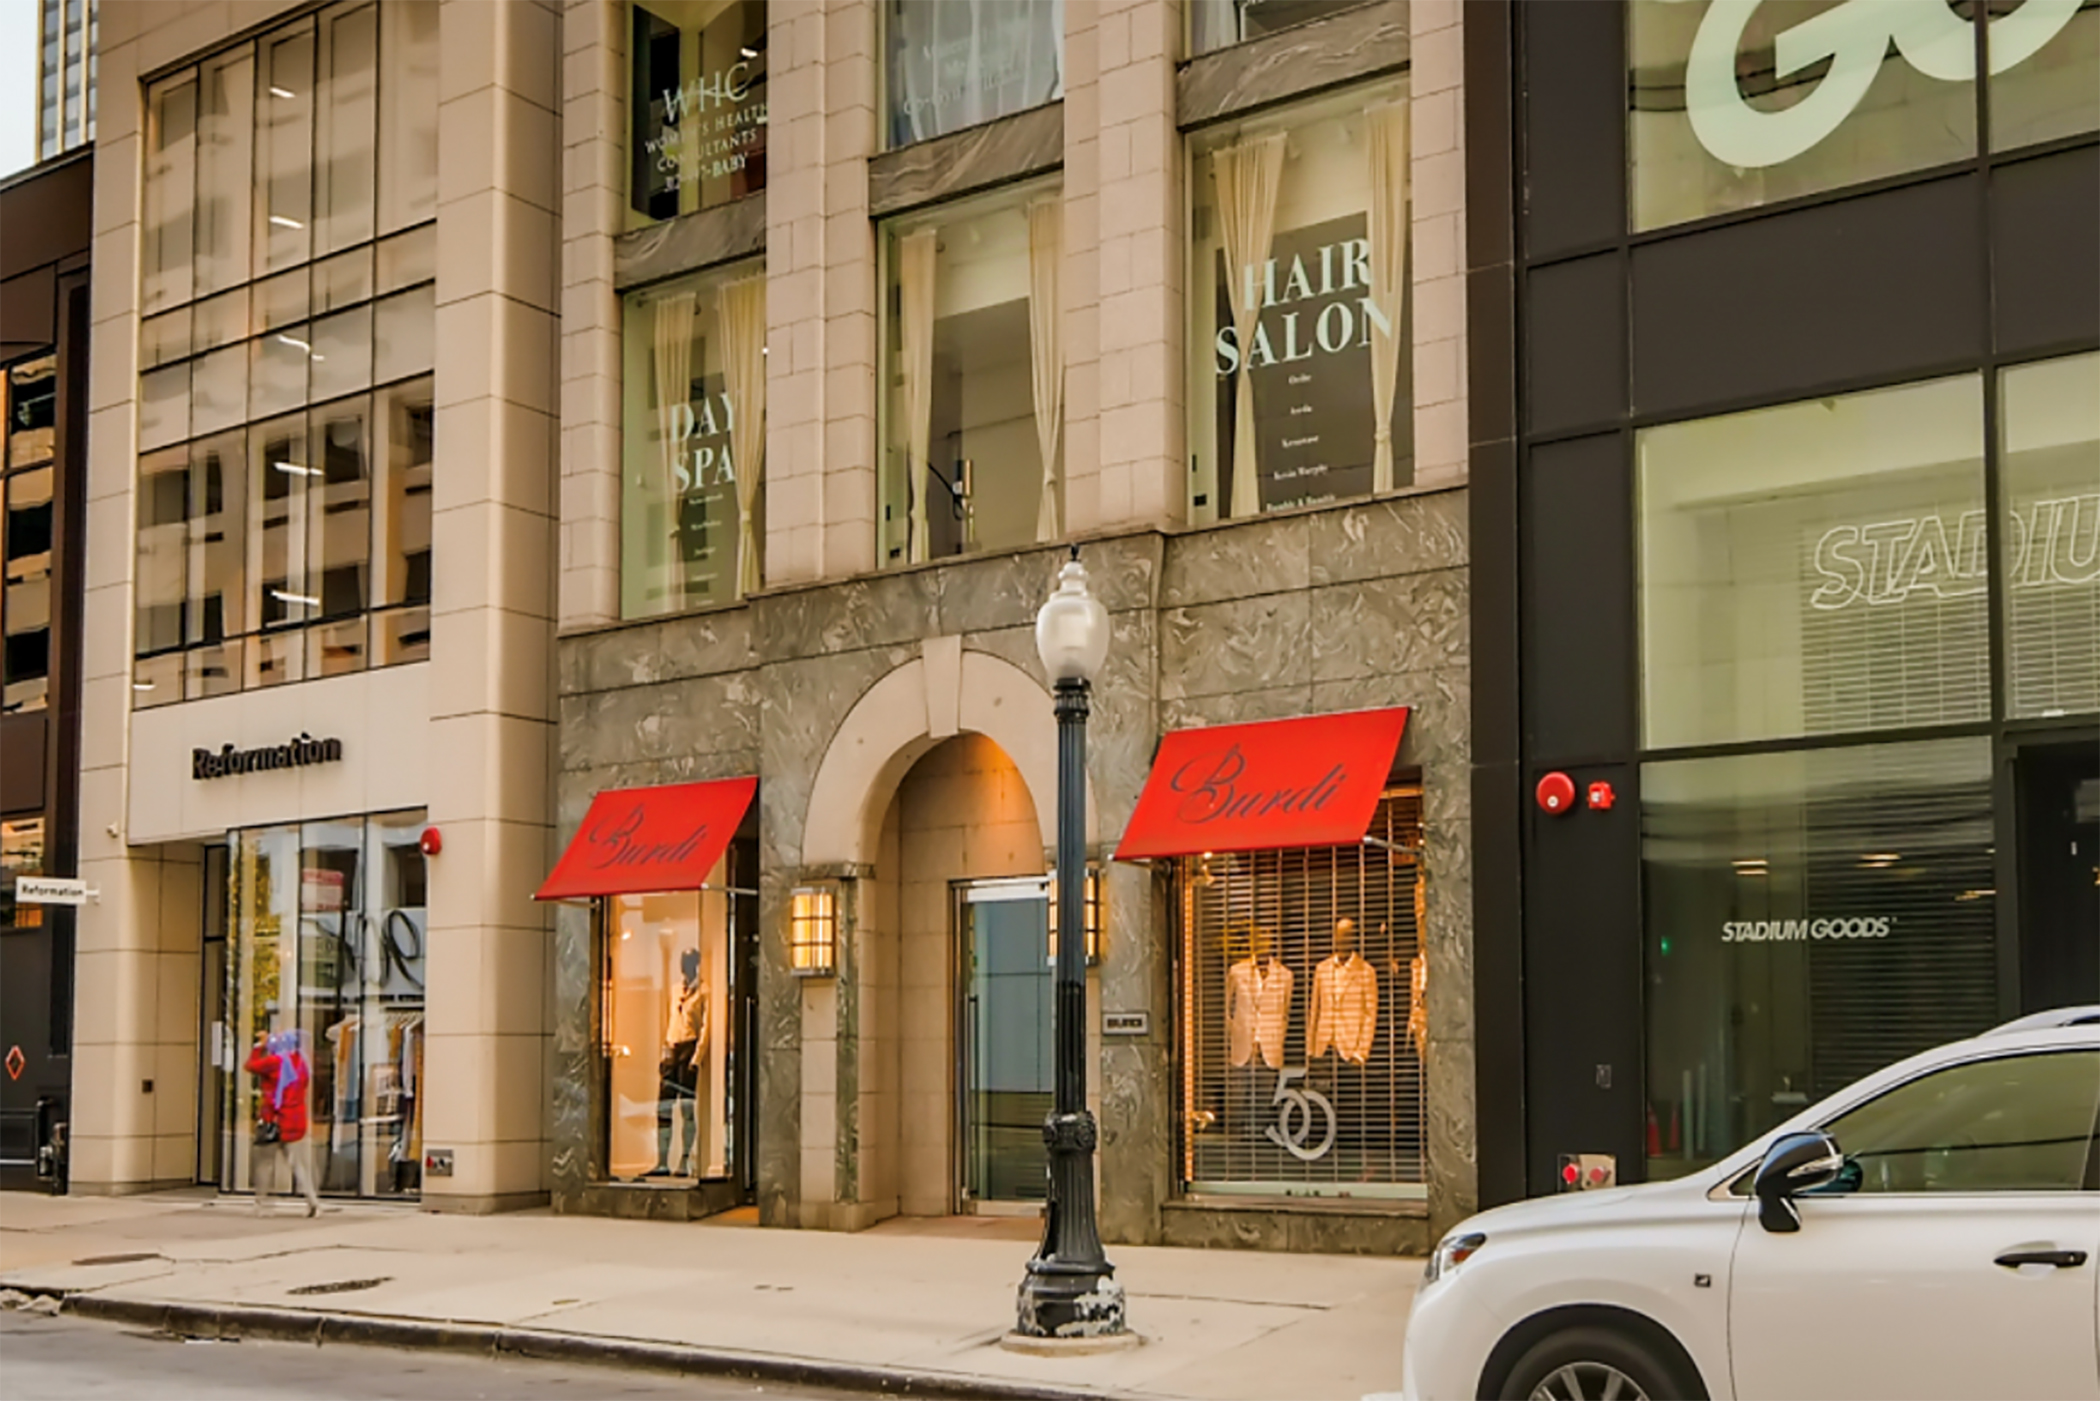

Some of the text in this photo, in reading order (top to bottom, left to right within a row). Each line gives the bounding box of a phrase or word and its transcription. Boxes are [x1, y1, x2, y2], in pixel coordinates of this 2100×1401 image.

[662, 62, 749, 123] WHC
[1244, 237, 1372, 311] HAIR
[1216, 296, 1391, 375] SALON
[670, 391, 734, 442] DAY
[673, 443, 736, 494] SPA
[192, 731, 342, 780] Reformation
[1169, 742, 1348, 825] Burdi
[588, 802, 708, 870] Burdi
[22, 882, 84, 897] Reformation
[1721, 918, 1808, 942] STADIUM
